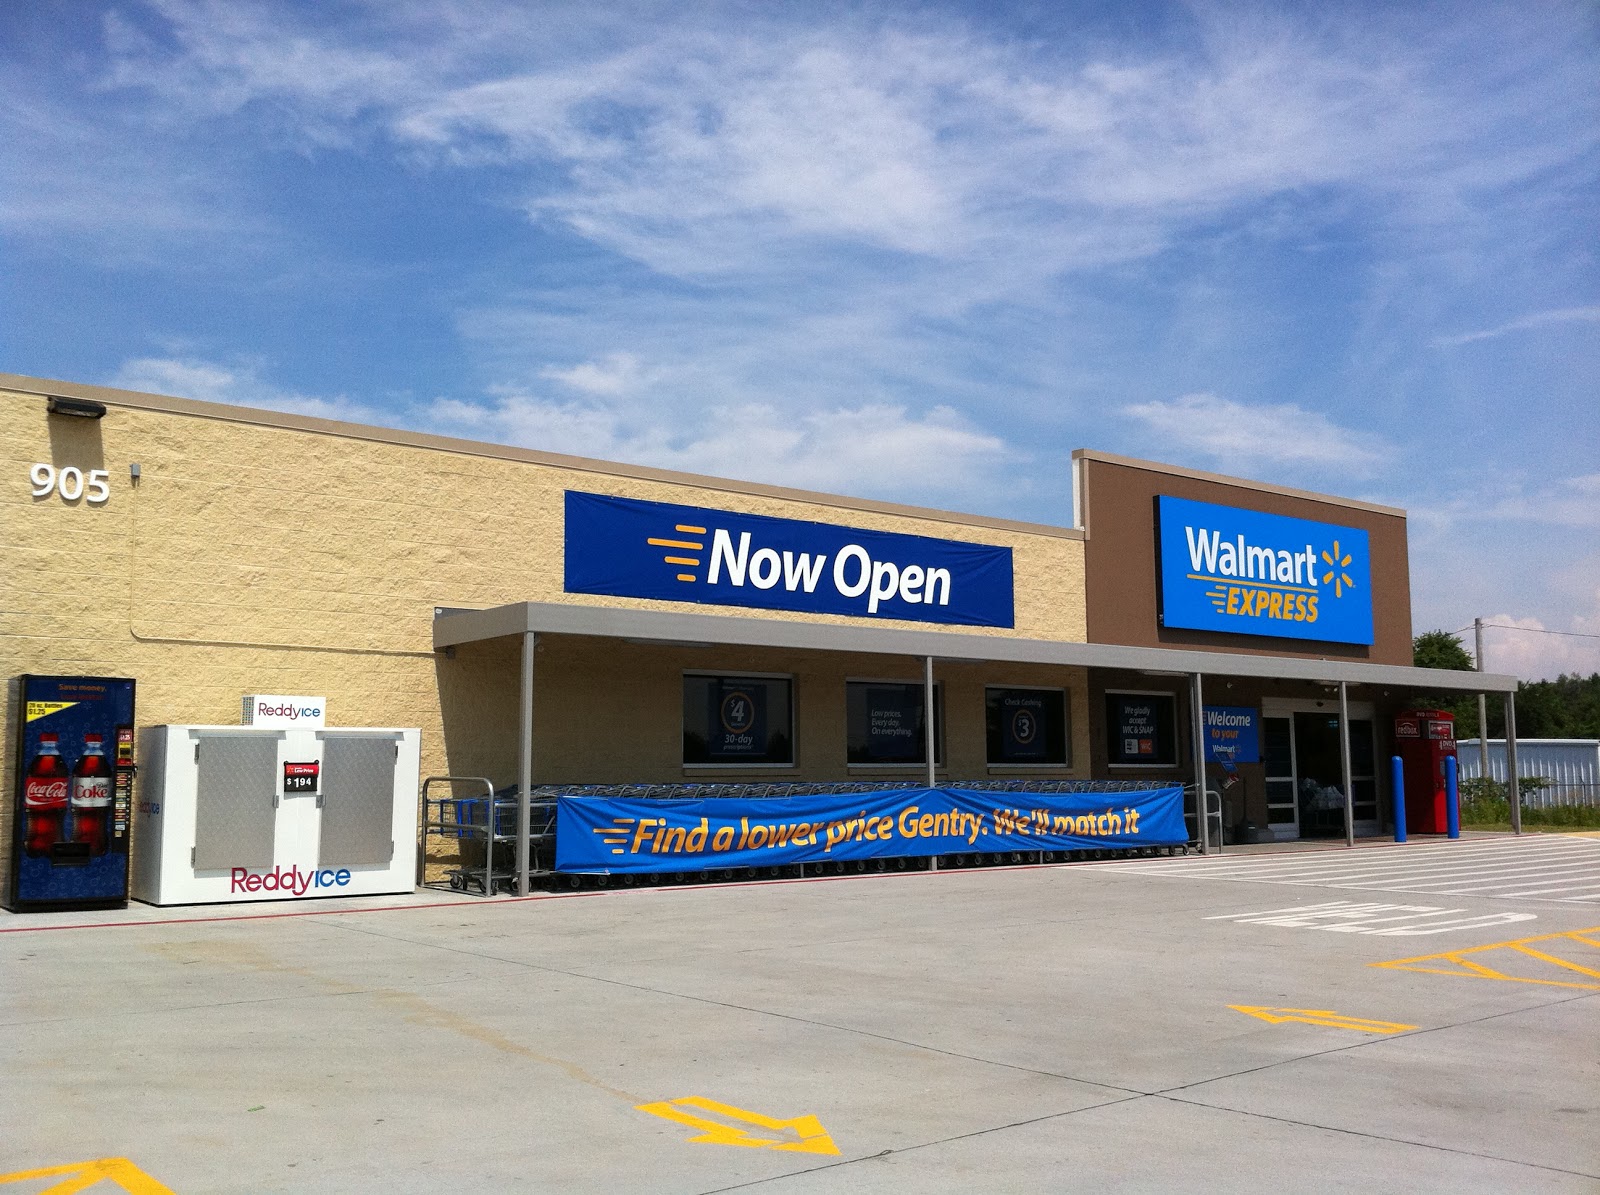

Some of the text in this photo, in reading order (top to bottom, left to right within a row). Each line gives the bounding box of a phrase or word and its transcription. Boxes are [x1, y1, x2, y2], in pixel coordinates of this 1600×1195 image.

[30, 463, 110, 502] 905
[1185, 526, 1318, 587] Walmart
[707, 528, 951, 614] Now Open
[1226, 587, 1319, 623] EXPRESS
[871, 709, 883, 717] Low
[1207, 711, 1251, 726] Welcome
[871, 727, 881, 735] On
[1211, 728, 1239, 741] to your
[725, 734, 753, 746] 30-day
[1212, 744, 1236, 753] Walmart
[27, 781, 68, 797] Coca-Cola
[74, 785, 108, 798] Coke
[630, 805, 1141, 854] Find a lower price Gentry. We'll match it
